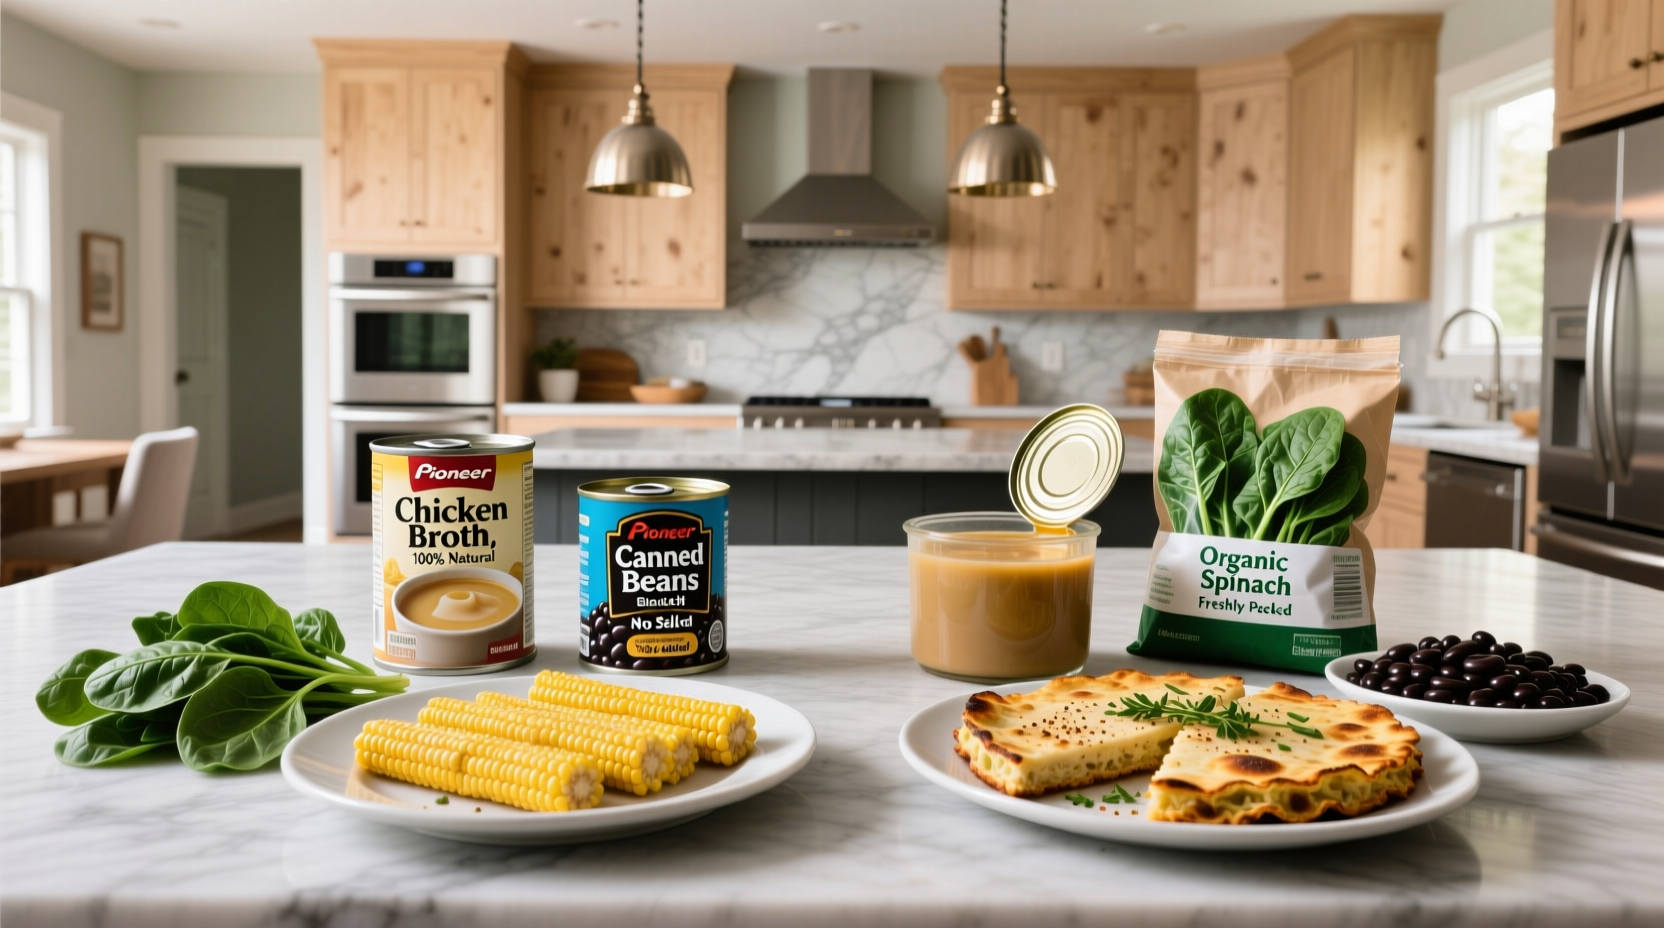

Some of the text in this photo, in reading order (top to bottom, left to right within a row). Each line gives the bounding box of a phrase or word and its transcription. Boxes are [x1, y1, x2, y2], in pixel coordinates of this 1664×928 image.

[414, 463, 492, 480] Pioneer
[395, 496, 508, 523] Chicken
[408, 523, 496, 550] Broth,
[627, 521, 697, 541] Pioneer
[413, 550, 495, 566] 100% Natural
[615, 542, 704, 568] Canned
[1200, 545, 1289, 574] Organic
[621, 570, 699, 593] Beans
[1200, 569, 1291, 596] Spinach
[1198, 596, 1245, 615] Freshly
[631, 616, 652, 630] No
